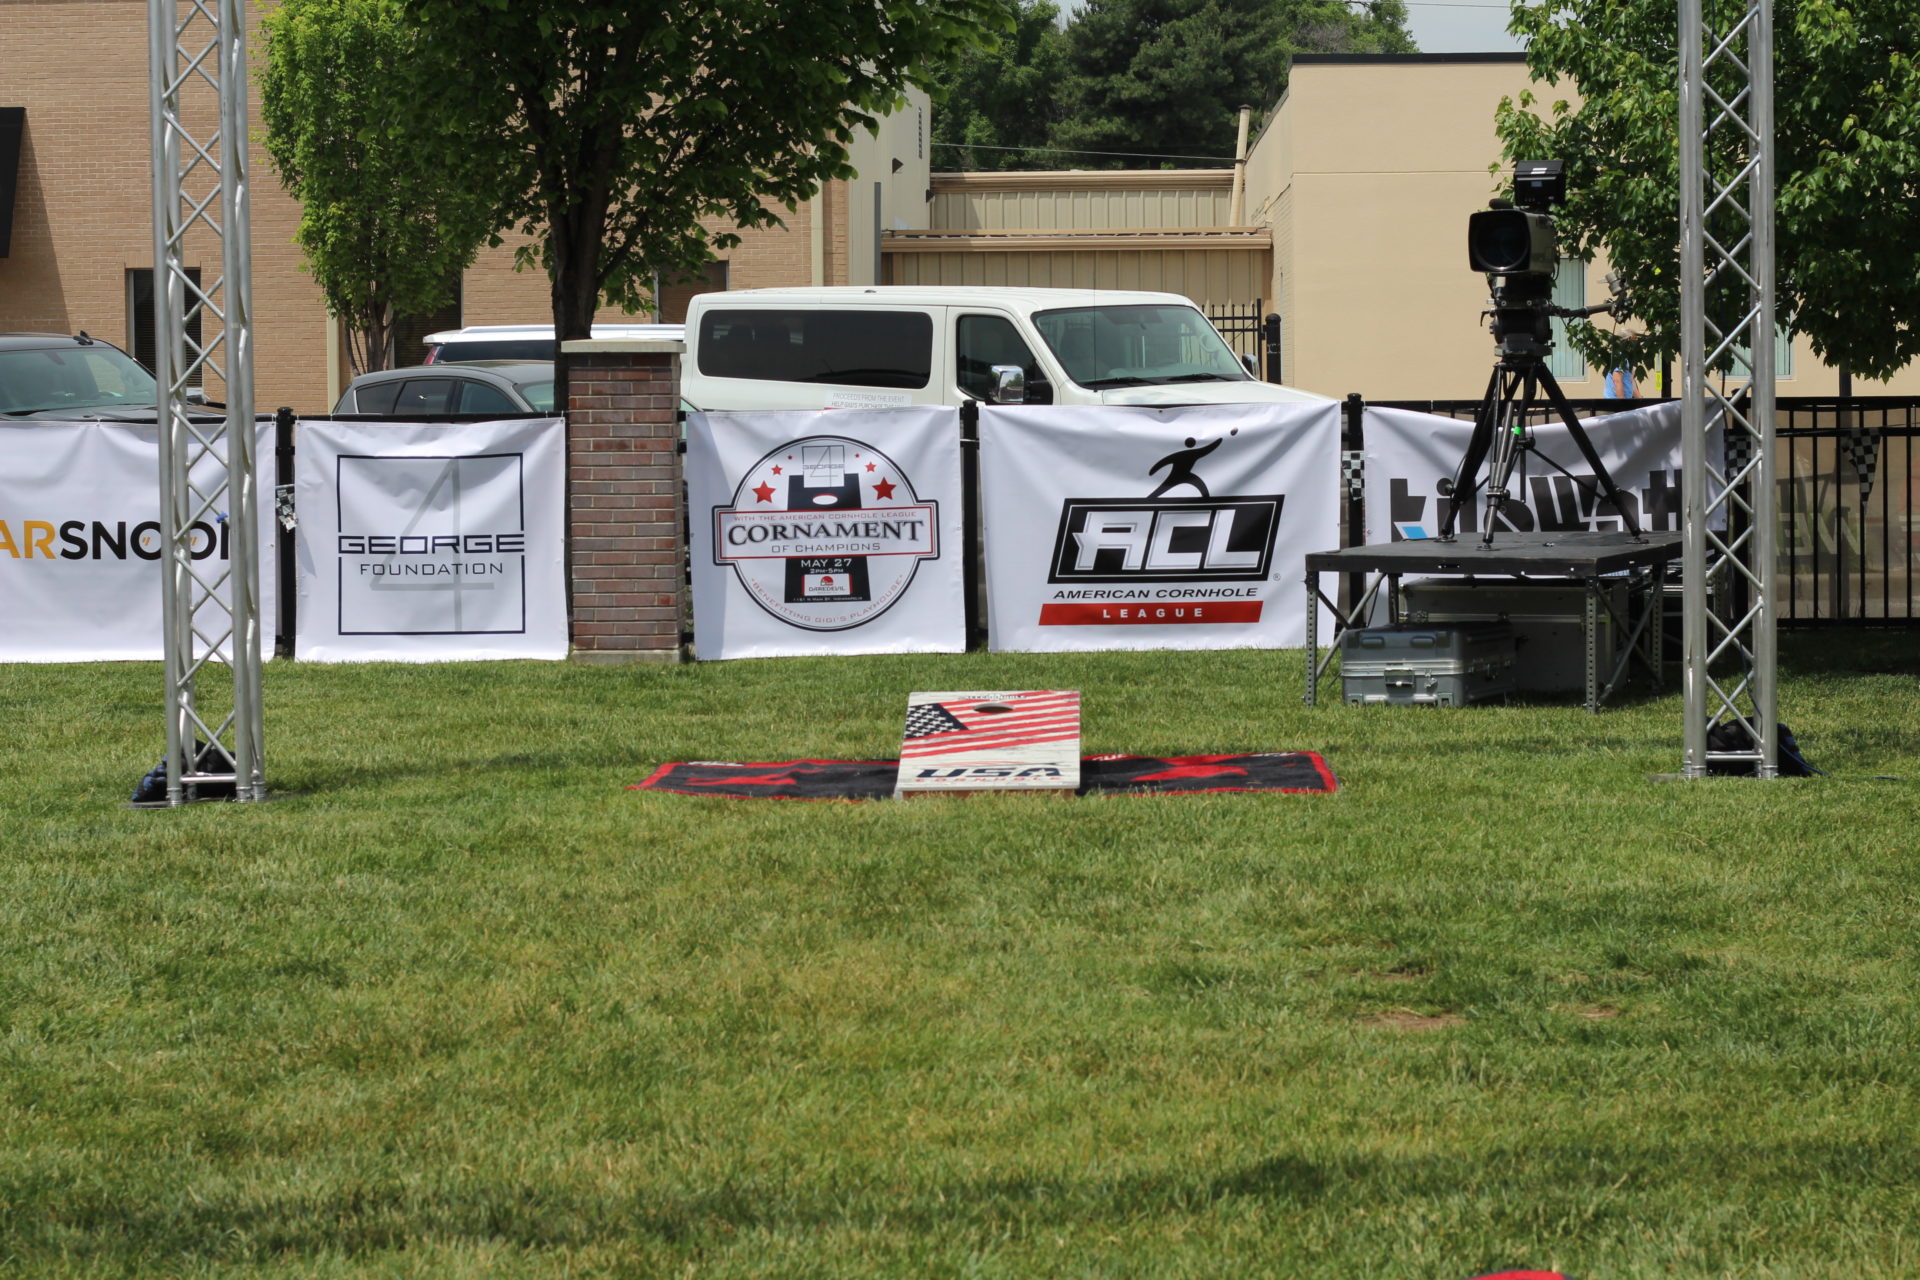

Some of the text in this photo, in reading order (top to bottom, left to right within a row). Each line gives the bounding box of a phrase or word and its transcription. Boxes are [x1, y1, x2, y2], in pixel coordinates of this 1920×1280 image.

[728, 520, 924, 546] CORNAMENT
[338, 534, 525, 554] GEORGE
[1072, 509, 1261, 571] ACL
[771, 543, 880, 553] OF CHAMPIONS
[360, 562, 503, 575] FOUNDATION
[801, 558, 852, 568] MAY 27
[1053, 588, 1258, 600] AMERICAN CORNHOLE
[1102, 608, 1203, 618] LEAGUE
[917, 767, 1062, 778] USA
